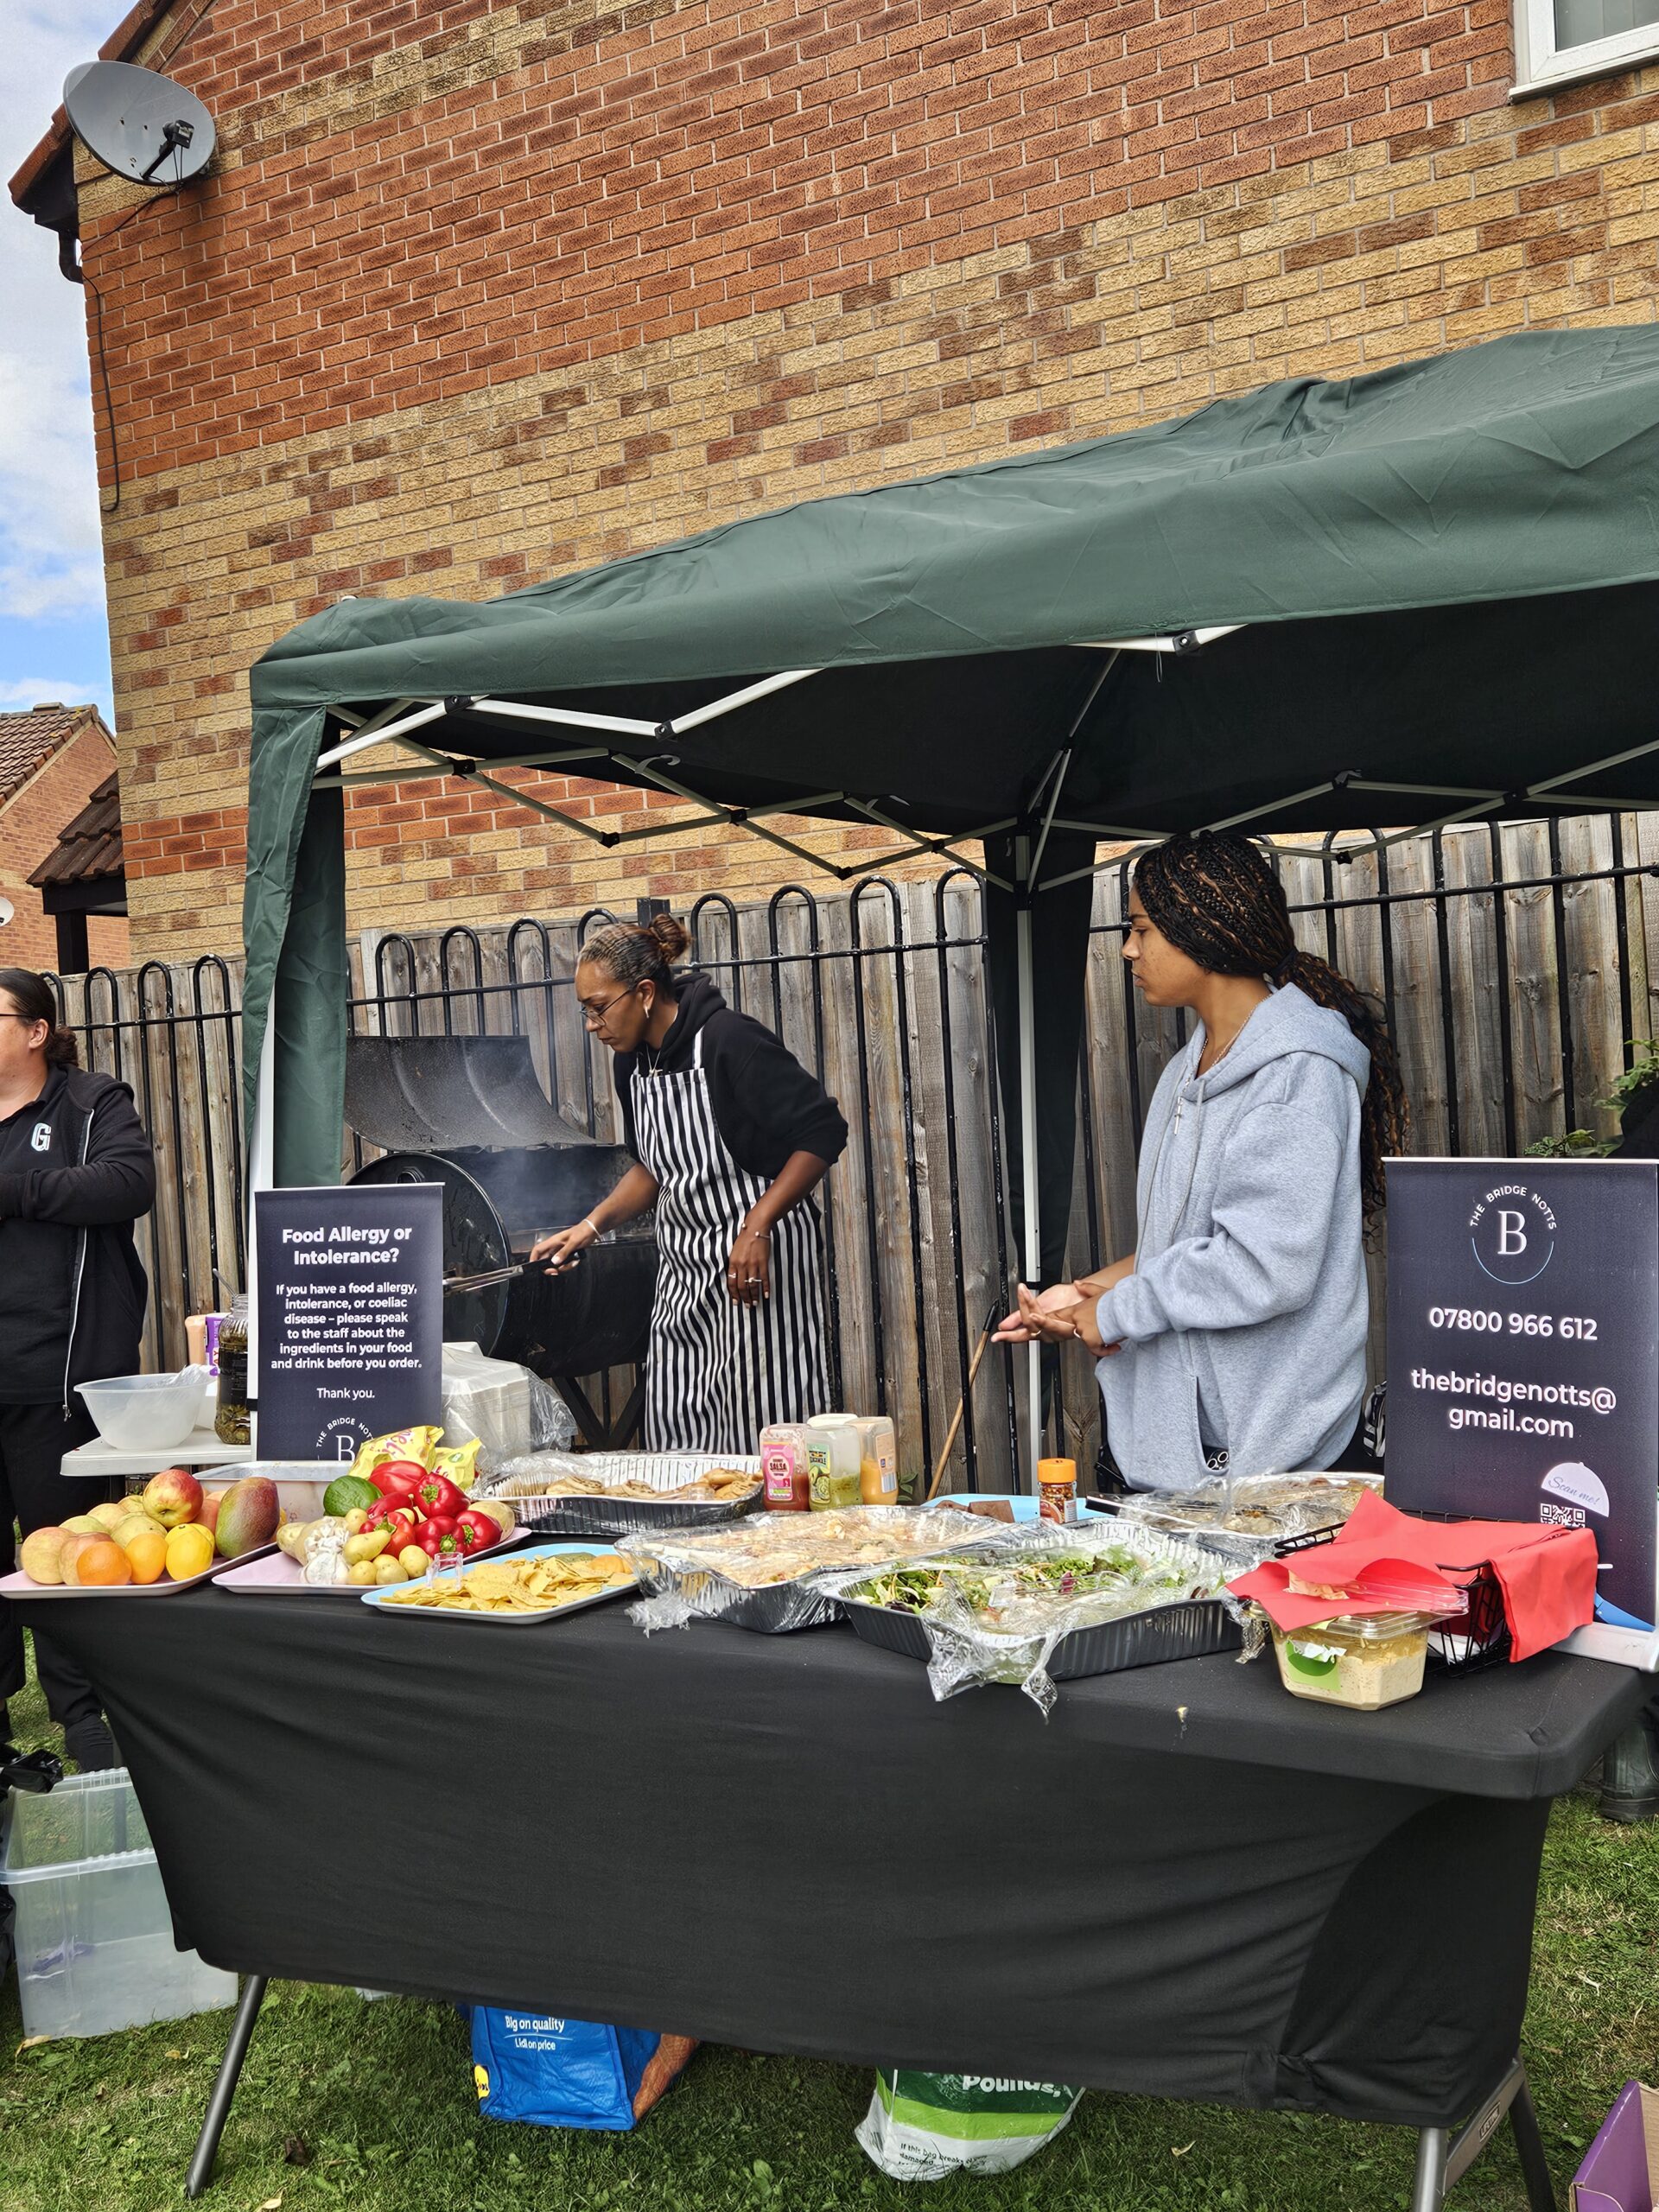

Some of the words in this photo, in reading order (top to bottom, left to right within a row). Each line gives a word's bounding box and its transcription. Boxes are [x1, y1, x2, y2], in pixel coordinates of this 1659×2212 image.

[31, 1122, 52, 1152] G
[1470, 1203, 1486, 1227] THE
[1485, 1185, 1528, 1203] BRIDGE
[1531, 1193, 1558, 1230] NOTTS
[283, 1227, 324, 1243] Food
[328, 1226, 390, 1244] Allergy
[394, 1228, 412, 1240] or
[1497, 1210, 1528, 1255] B
[295, 1248, 399, 1265] Intolerance?
[276, 1284, 284, 1294] If
[286, 1287, 307, 1297] you
[310, 1284, 336, 1294] have
[349, 1282, 374, 1293] food
[377, 1282, 417, 1294] allergy,
[286, 1299, 351, 1310] intolerance,
[368, 1296, 407, 1307] coeliac
[284, 1313, 326, 1324] disease
[337, 1313, 372, 1325] please
[376, 1312, 408, 1325] speak
[1429, 1307, 1502, 1332] 07800
[1508, 1313, 1553, 1337] 966
[1559, 1317, 1598, 1340] 612
[287, 1330, 299, 1338] to
[302, 1328, 321, 1338] the
[323, 1328, 349, 1338] staff
[352, 1327, 384, 1338] about
[386, 1327, 404, 1338] the
[280, 1343, 343, 1356] ingredients
[346, 1342, 357, 1353] in
[359, 1344, 385, 1355] your
[387, 1342, 412, 1352] food
[271, 1358, 292, 1369] and
[296, 1357, 324, 1368] drink
[327, 1357, 363, 1368] before
[365, 1360, 385, 1370] you
[389, 1357, 422, 1368] order.
[317, 1388, 350, 1398] Thank
[353, 1390, 375, 1401] you.
[1411, 1368, 1616, 1415] thebridgenotts@
[316, 1431, 327, 1447] THE
[327, 1417, 355, 1430] BRIDGE
[1449, 1408, 1574, 1438] gmail.com
[335, 1435, 355, 1461] B
[1548, 1477, 1576, 1496] Scan
[1579, 1493, 1600, 1504] me!
[505, 2015, 518, 2031] Big
[518, 2019, 531, 2030] on
[532, 2017, 564, 2033] quality
[514, 2037, 527, 2048] Lidl
[537, 2039, 556, 2051] price
